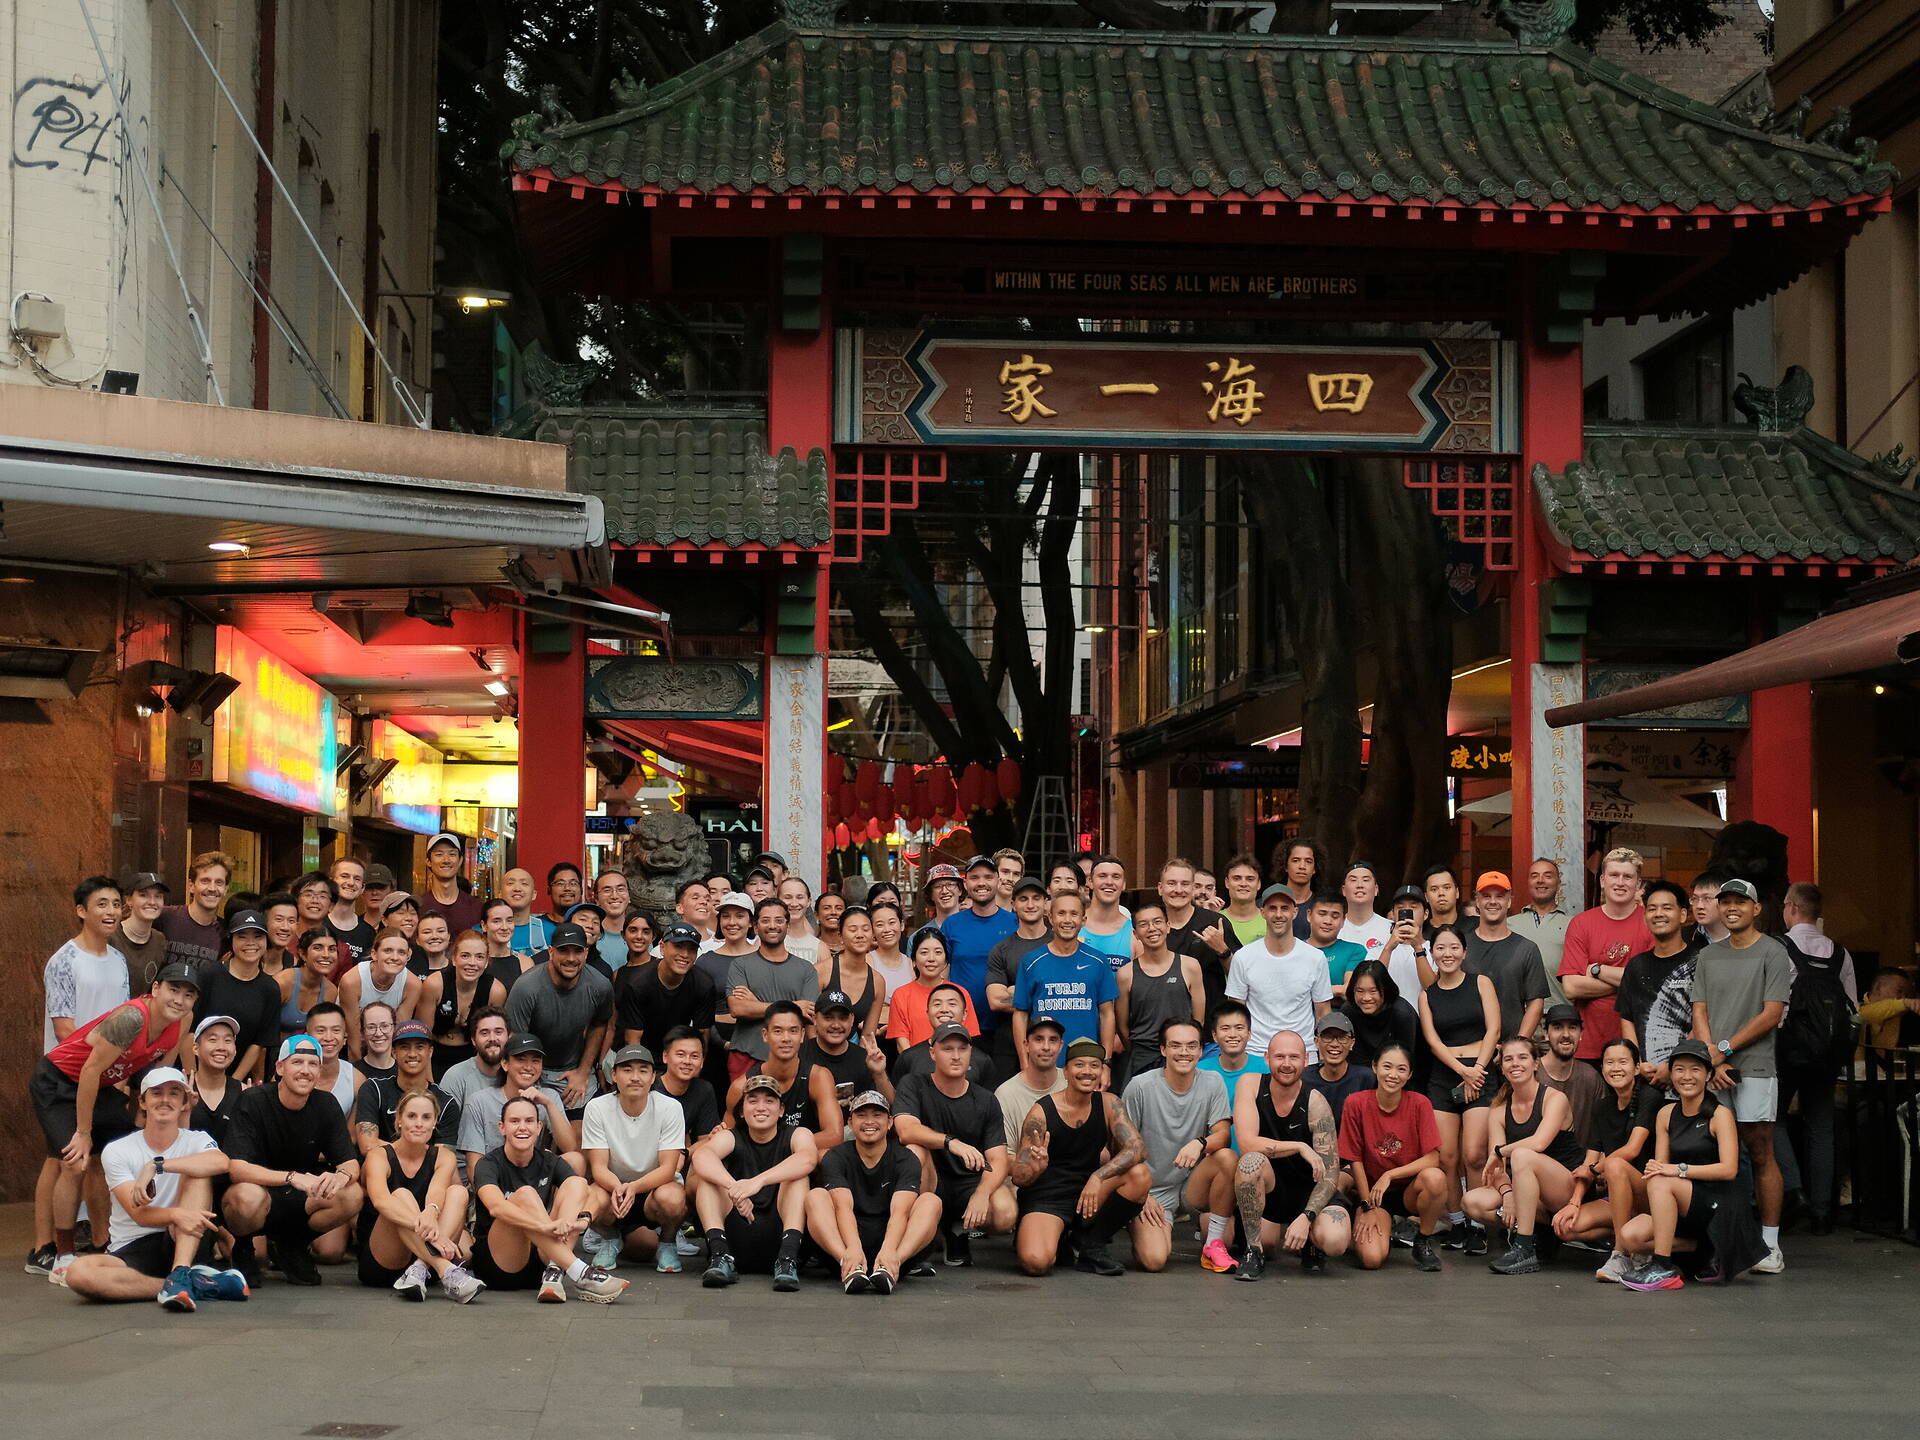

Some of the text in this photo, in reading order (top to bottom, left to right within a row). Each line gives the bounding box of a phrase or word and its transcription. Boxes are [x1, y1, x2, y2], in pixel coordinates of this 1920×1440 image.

[995, 271, 1358, 295] WITHIN THE FOUR SEAS ALL MEN ARE BROTHERS
[1590, 802, 1634, 811] EAT
[1588, 811, 1634, 819] THERN
[708, 819, 764, 832] HAL
[1107, 957, 1124, 965] ncer
[1044, 982, 1086, 995] TURBO
[1037, 998, 1093, 1012] RUNNERS
